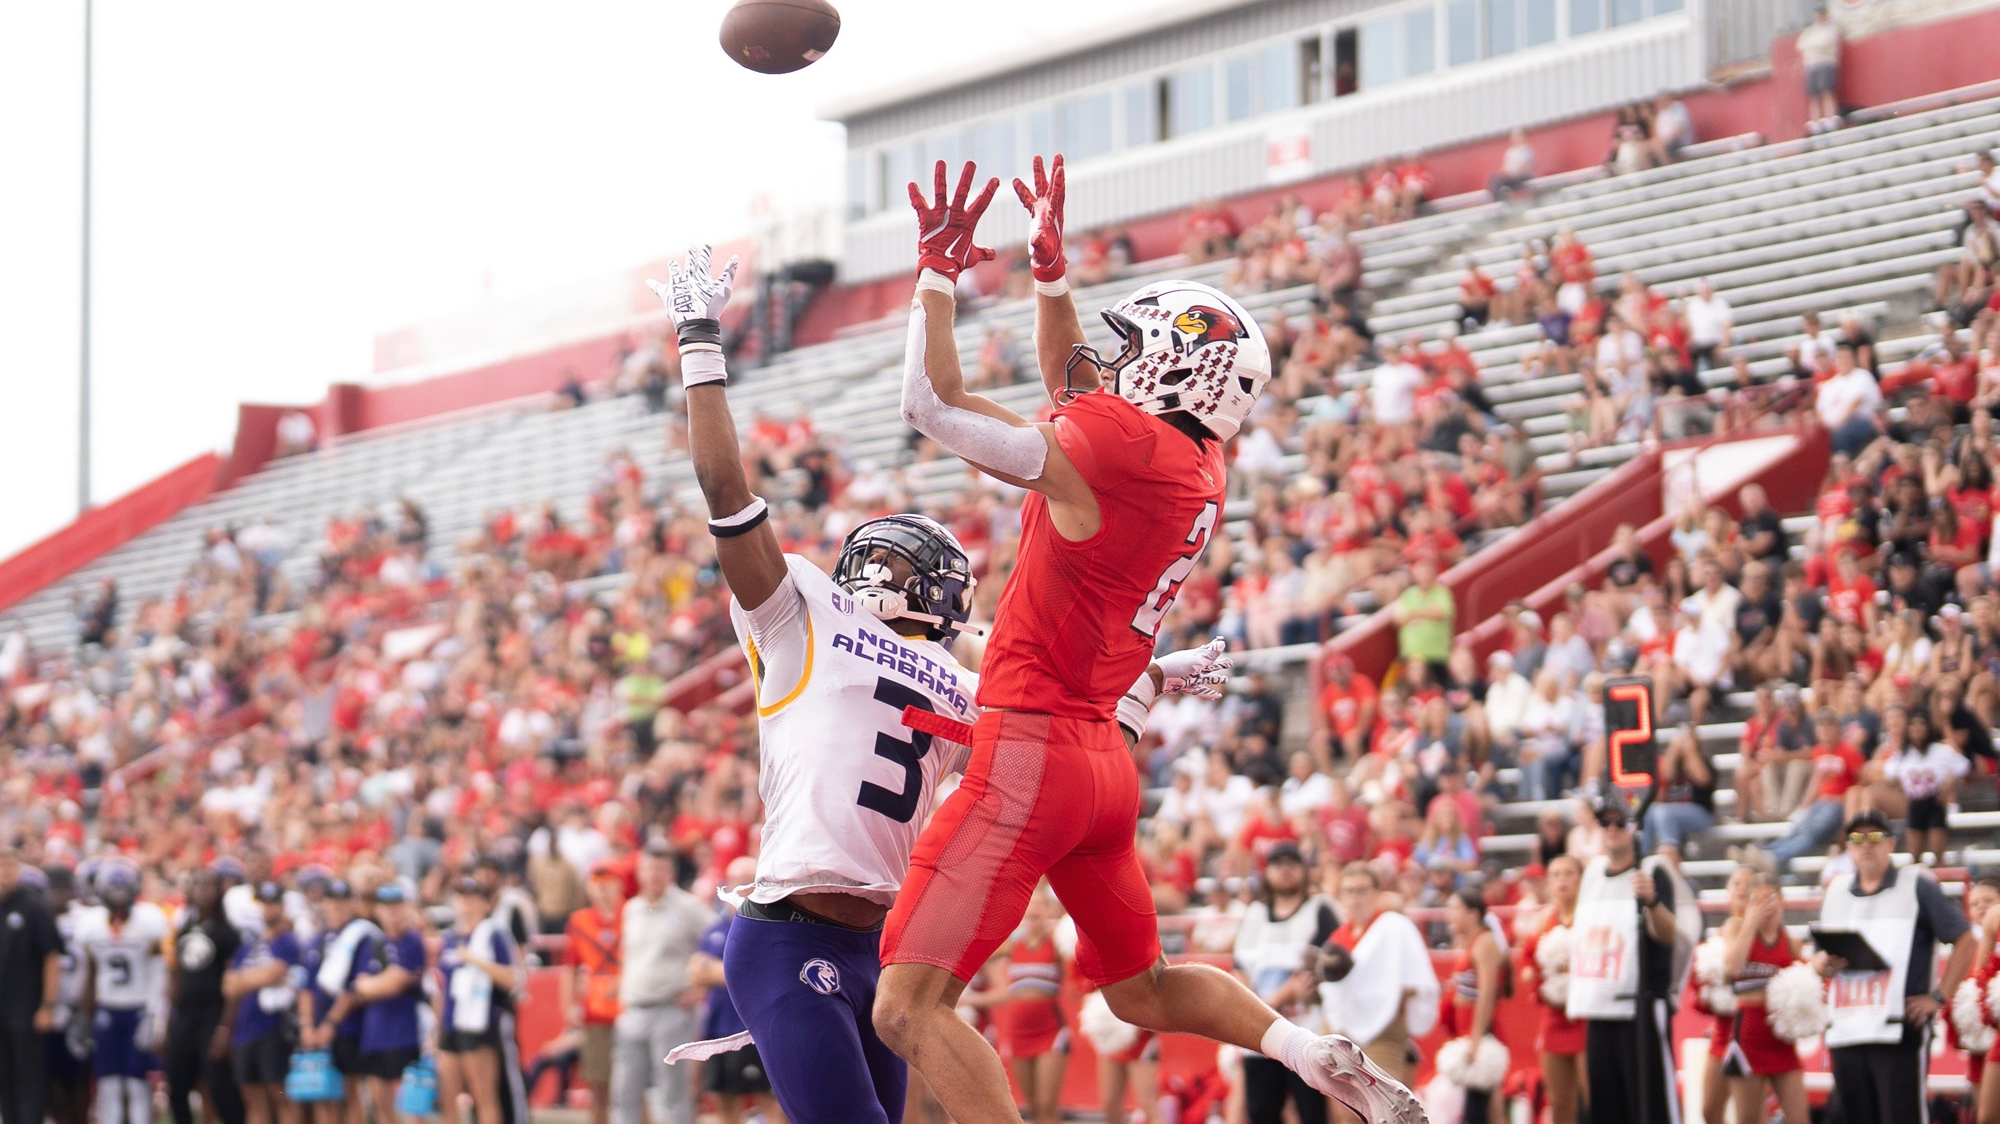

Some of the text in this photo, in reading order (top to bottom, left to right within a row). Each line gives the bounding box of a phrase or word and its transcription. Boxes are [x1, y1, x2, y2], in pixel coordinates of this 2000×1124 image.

[1130, 499, 1219, 639] 2
[832, 633, 968, 716] ALABAMA
[858, 627, 958, 687] NORTH
[856, 675, 936, 824] 3
[1609, 685, 1653, 788] 2
